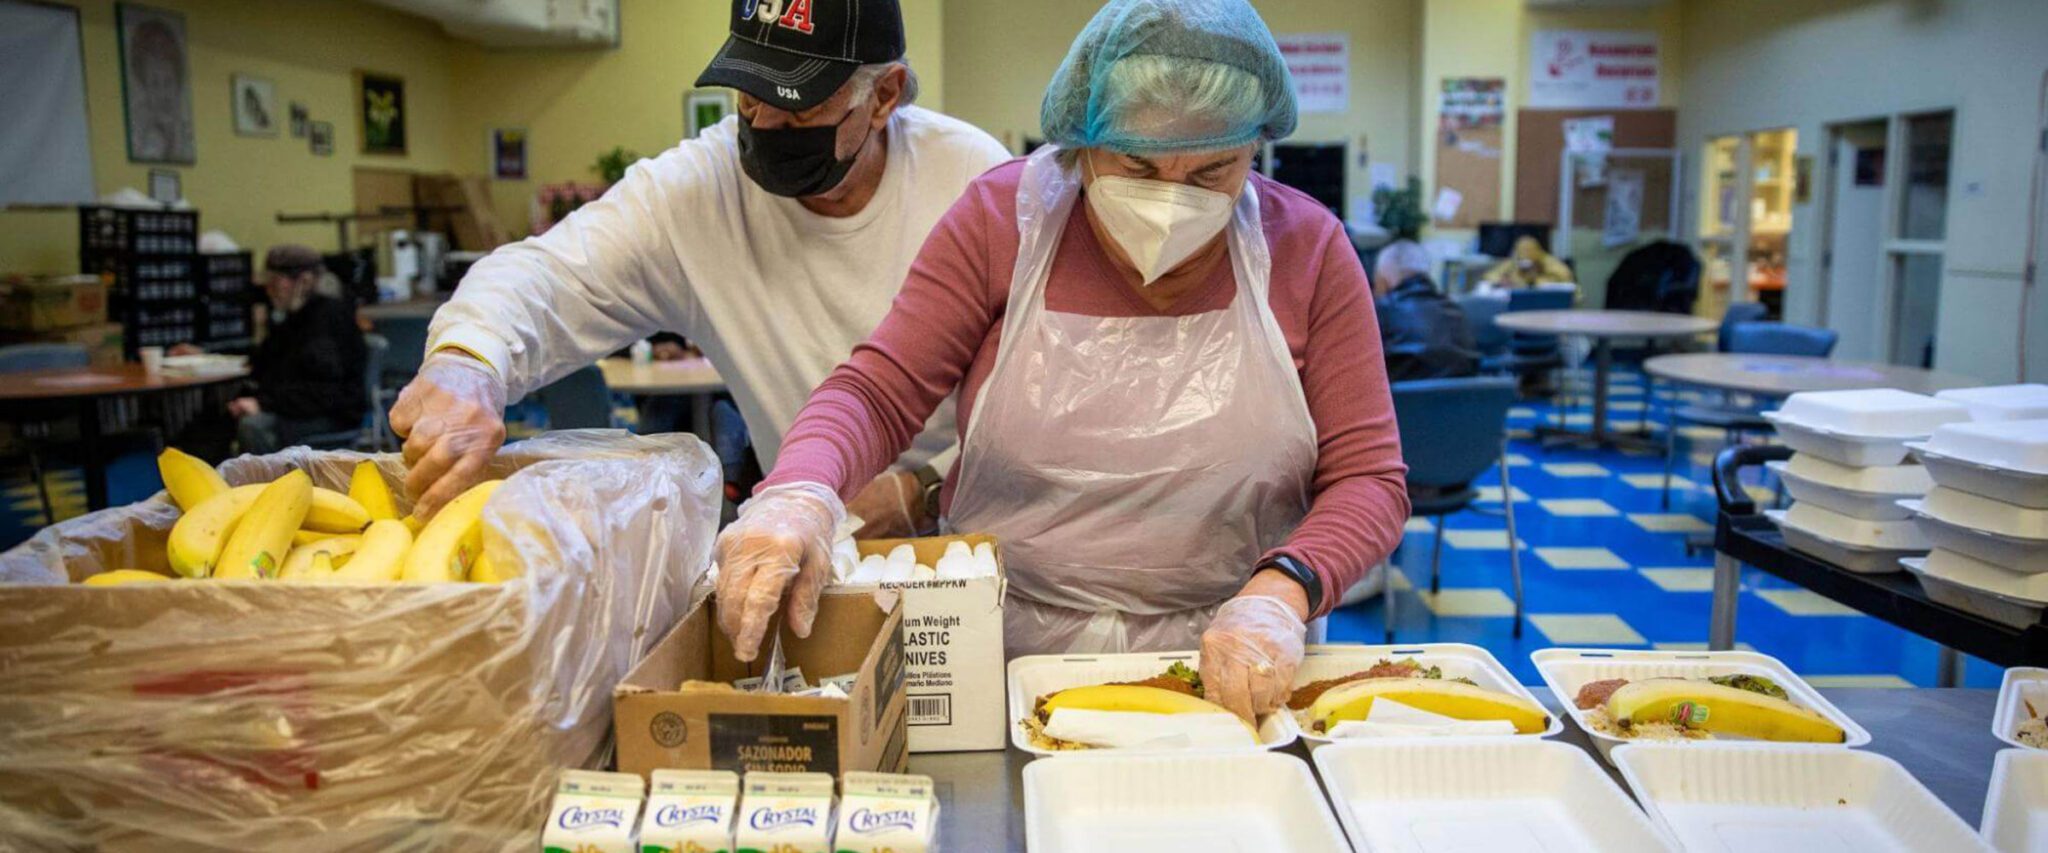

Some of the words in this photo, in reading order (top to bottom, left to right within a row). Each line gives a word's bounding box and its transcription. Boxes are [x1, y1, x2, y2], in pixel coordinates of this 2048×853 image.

[777, 86, 800, 100] USA
[923, 615, 961, 629] Weight
[904, 632, 950, 647] ASTIC
[905, 651, 947, 665] NIVES
[737, 745, 812, 761] SAZONADOR
[559, 806, 624, 830] CRYSTAL
[656, 804, 723, 828] CRYSTAL
[750, 806, 818, 831] CRYSTAL
[849, 807, 916, 833] CRYSTAL
